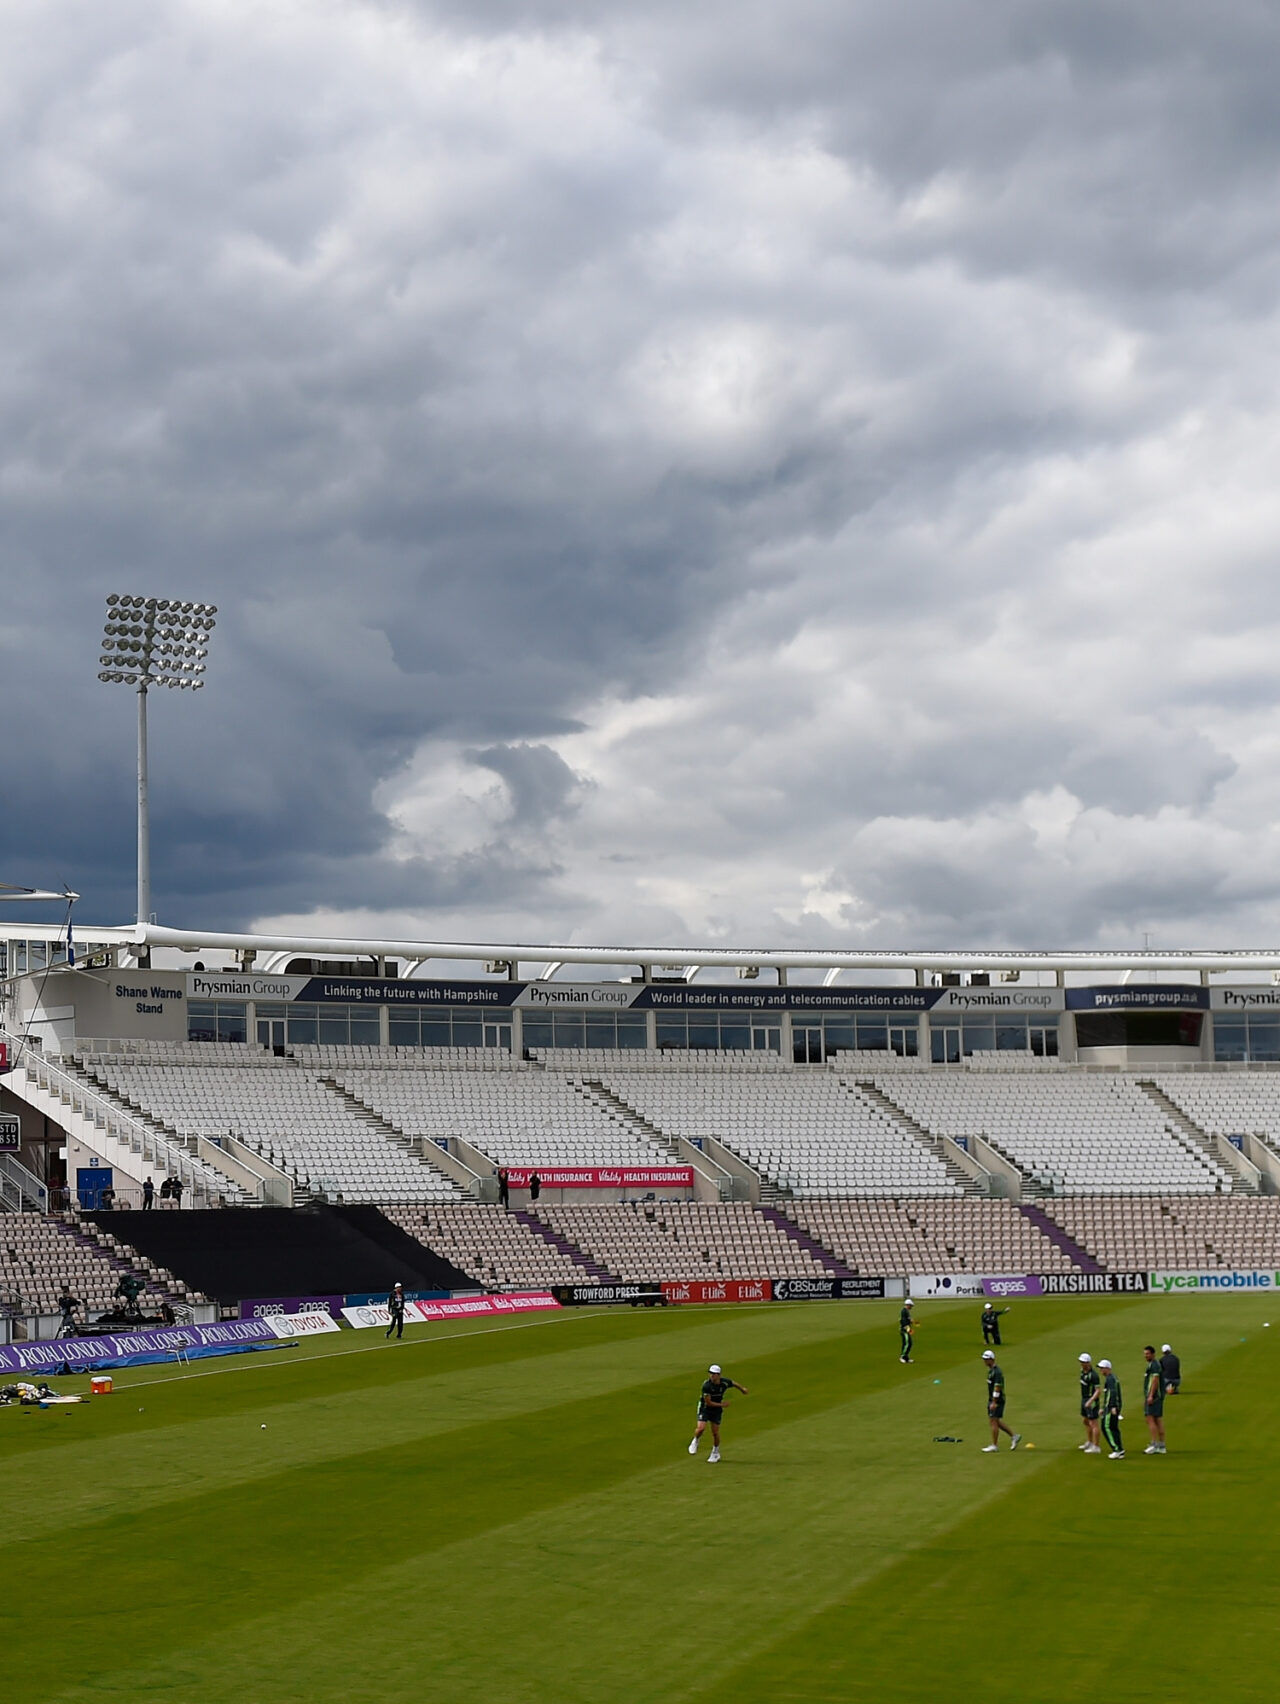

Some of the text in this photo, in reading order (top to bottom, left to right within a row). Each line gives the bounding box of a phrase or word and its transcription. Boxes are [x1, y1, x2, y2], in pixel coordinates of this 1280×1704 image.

[116, 985, 182, 1000] Shane Warne
[193, 978, 290, 998] Prysmian Group
[324, 984, 498, 1003] Linking the future with Hampshire
[531, 988, 628, 1006] Prysmian Group
[651, 992, 925, 1007] World leader in energy and telecommunication cables
[949, 992, 1051, 1009] Prysmian Group
[1224, 991, 1280, 1008] Prysmia
[136, 1003, 163, 1014] Stand
[554, 1173, 593, 1182] INSURANCE
[598, 1169, 689, 1185] Vitality HEALTH INSURANCE
[989, 1281, 1027, 1296] ageas
[1040, 1273, 1144, 1292] ORKSHIRE TEA
[1151, 1271, 1271, 1292] Lycamobile
[573, 1286, 640, 1300] STOWFORD PRESS
[289, 1316, 329, 1331] TOYOTA
[202, 1321, 273, 1344] ROYAL LONDON
[119, 1330, 198, 1353] ROYAL LONDON
[24, 1340, 112, 1366] ROYAL LONDON
